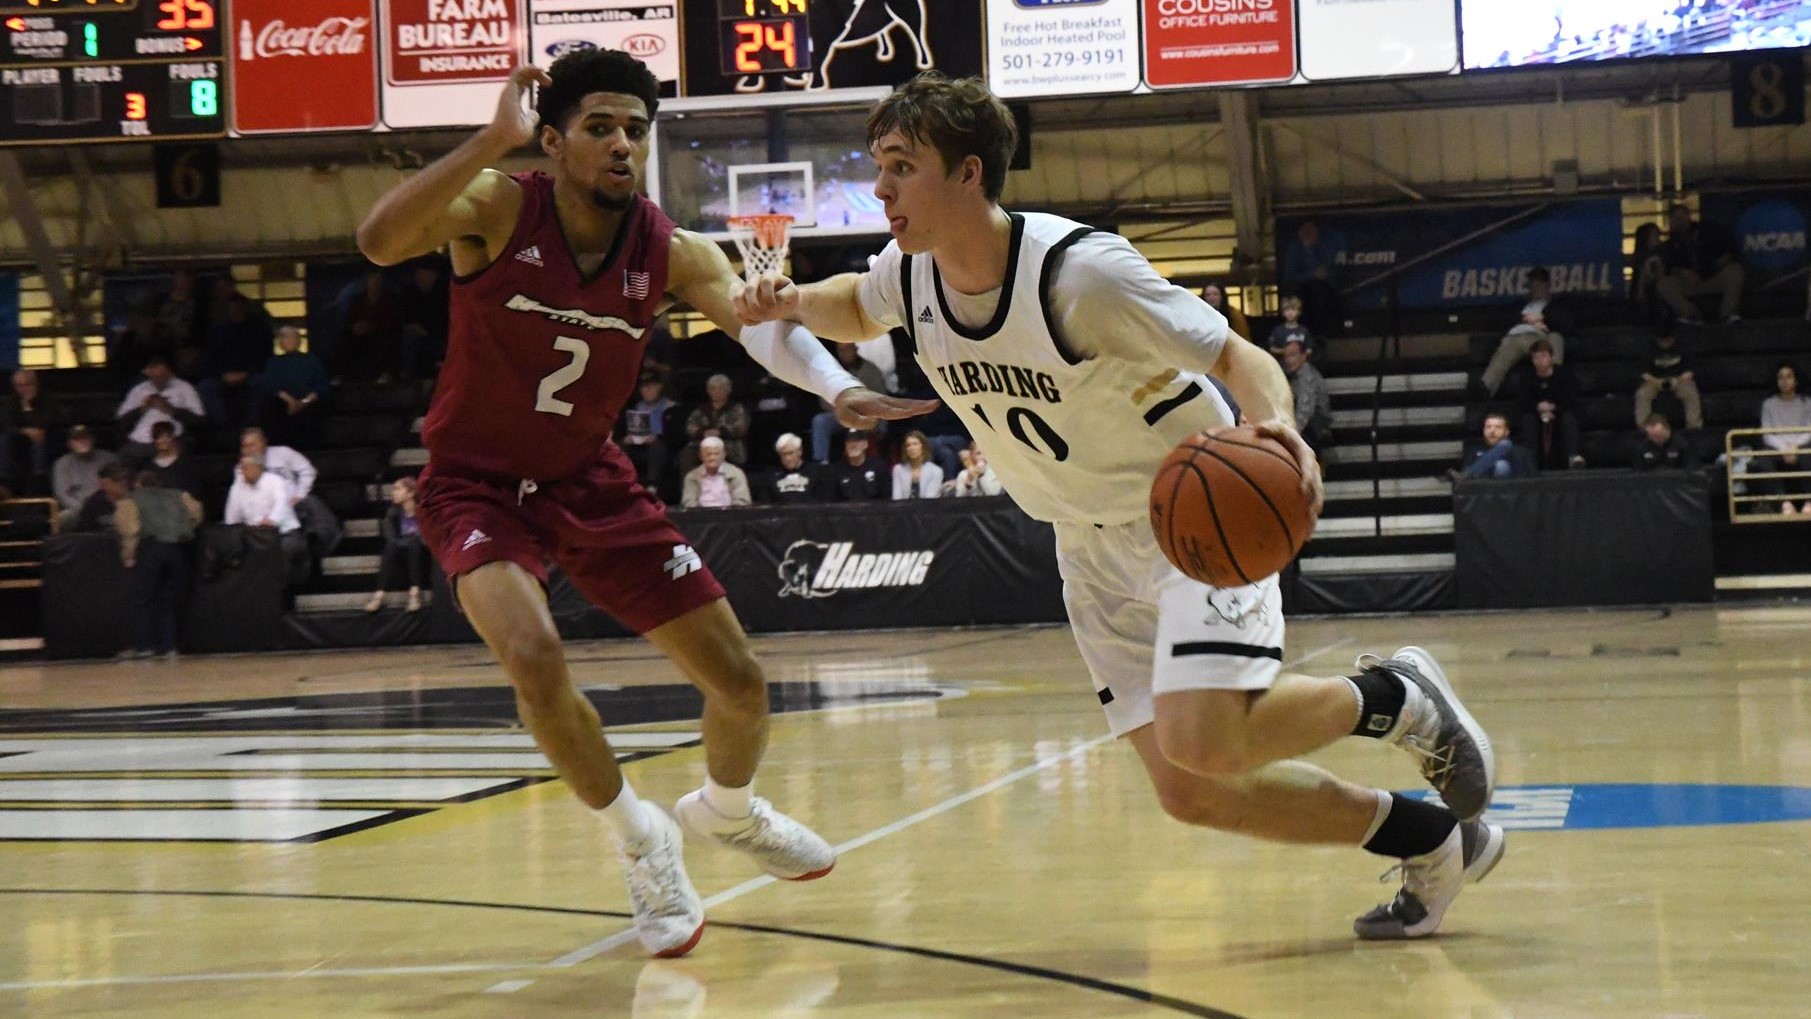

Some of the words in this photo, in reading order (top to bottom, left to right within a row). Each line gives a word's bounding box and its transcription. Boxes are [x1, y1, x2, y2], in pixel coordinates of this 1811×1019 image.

[428, 0, 508, 20] FARM
[643, 7, 671, 19] AR
[1158, 0, 1273, 15] COUSINS
[1004, 22, 1030, 32] Free
[1035, 21, 1057, 31] Hot
[1062, 18, 1121, 30] Breakfast
[1159, 15, 1207, 29] OFFICE
[1209, 11, 1278, 25] FURNITURE
[398, 21, 510, 48] BUREAU
[1001, 35, 1043, 46] Indoor
[1048, 32, 1093, 44] Heated
[1098, 30, 1126, 41] Pool
[629, 39, 658, 51] KIA
[735, 22, 796, 72] 24
[420, 54, 510, 72] INSURANCE
[1002, 49, 1124, 70] 501-279-9191
[73, 66, 122, 82] FOULS
[169, 63, 218, 79] FOULS
[191, 80, 217, 115] 8
[1751, 63, 1786, 118] 8
[125, 93, 146, 119] 3
[1745, 232, 1806, 250] NCAA
[1442, 263, 1612, 298] BASKEBALL
[535, 335, 590, 417] 2
[811, 542, 935, 589] HARDING
